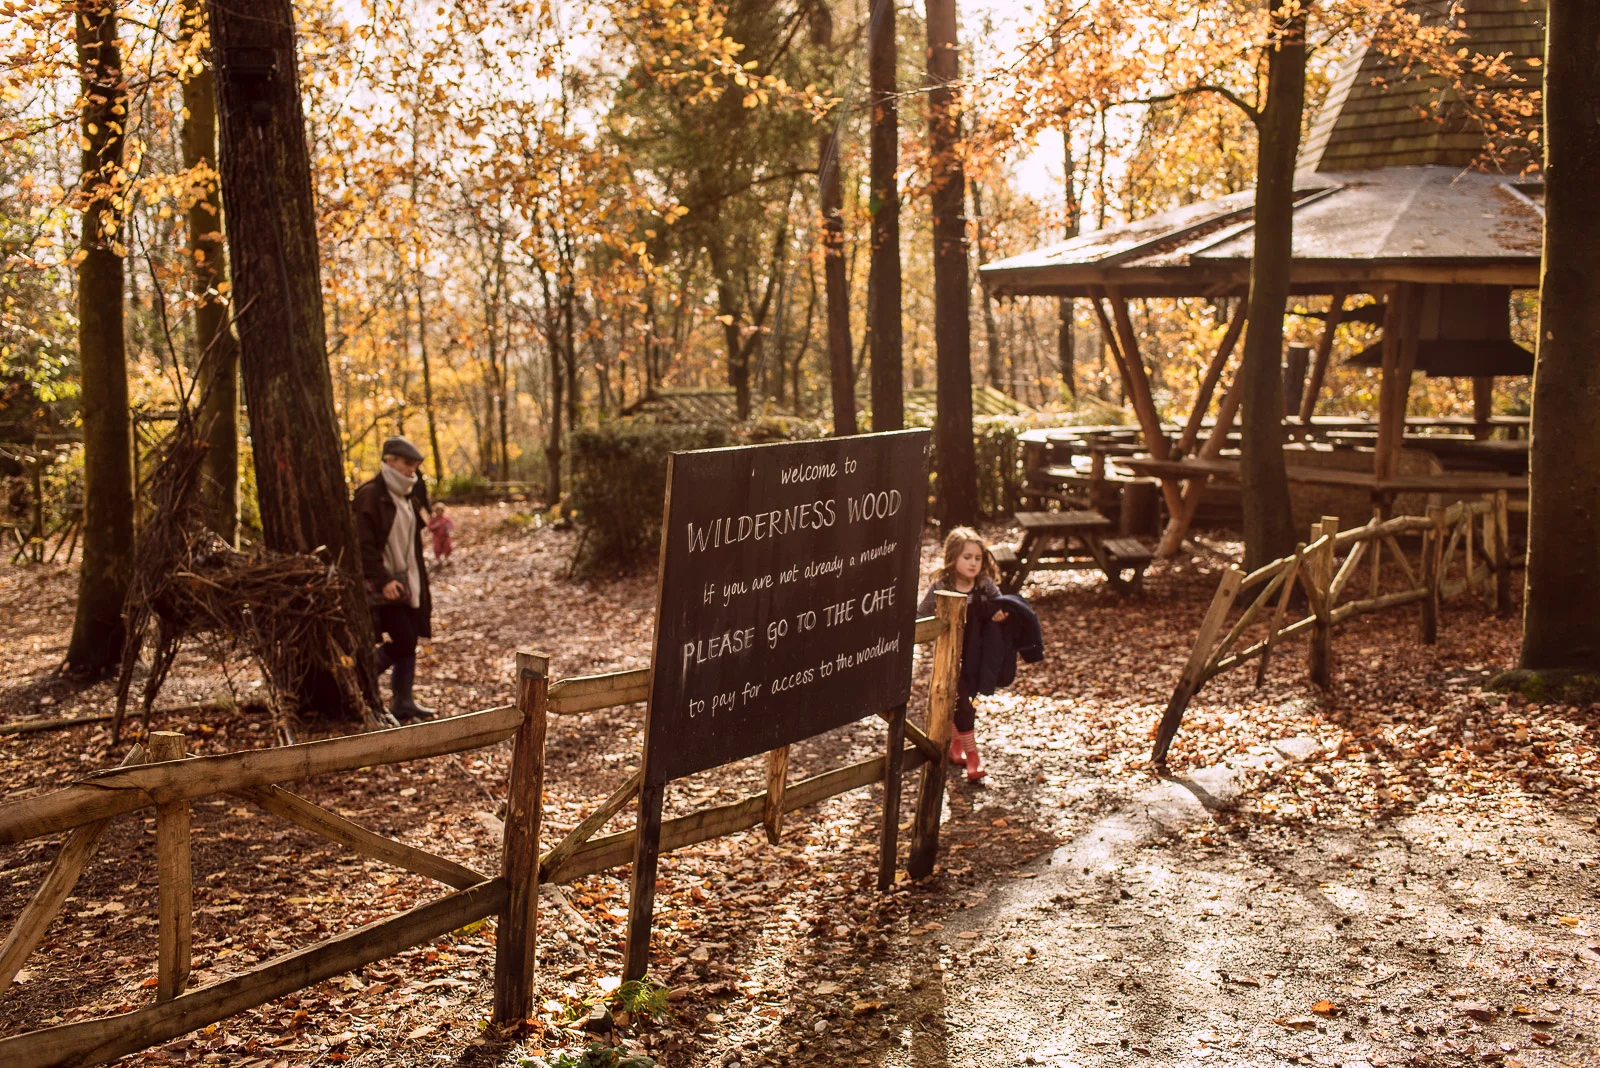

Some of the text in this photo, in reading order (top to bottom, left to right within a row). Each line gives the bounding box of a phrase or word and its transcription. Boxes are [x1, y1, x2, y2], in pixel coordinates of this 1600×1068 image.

[781, 456, 857, 485] welcome to
[687, 489, 902, 553] WILDERNESS WOOD
[723, 582, 747, 606] you
[752, 574, 774, 591] are
[779, 564, 799, 584] not
[804, 555, 843, 578] already
[849, 556, 855, 566] a
[860, 540, 897, 563] member
[683, 577, 898, 664] PLEASE GO TO THE CAFÉ
[689, 633, 900, 718] to pay for access to the woodland
